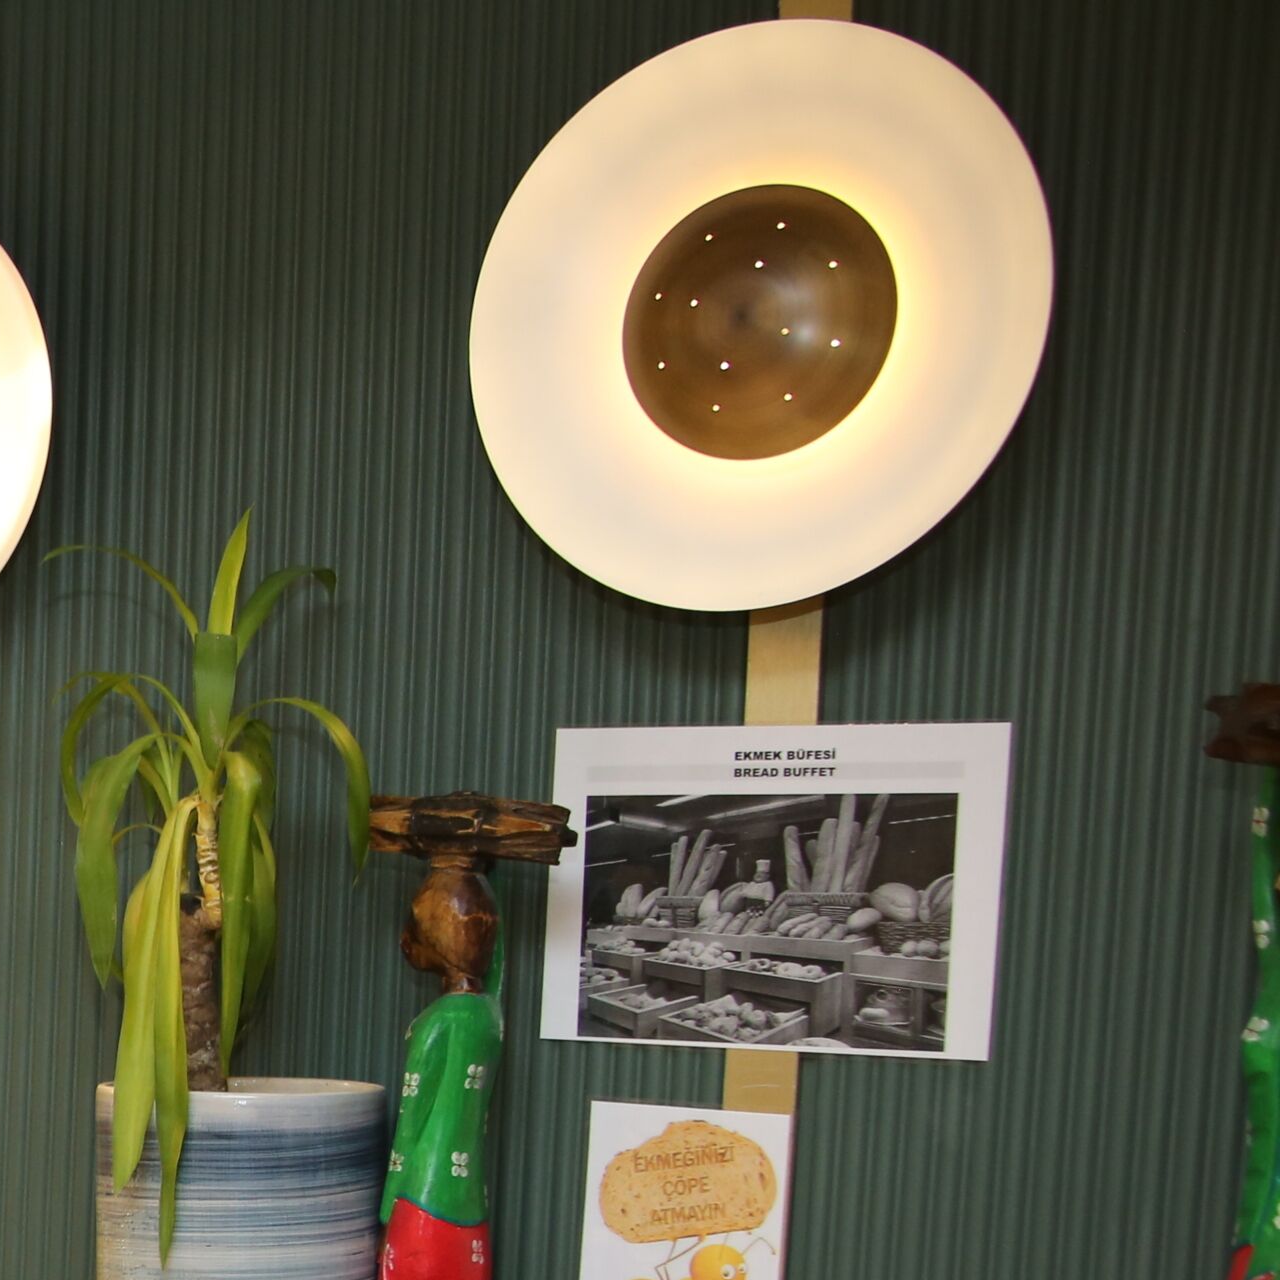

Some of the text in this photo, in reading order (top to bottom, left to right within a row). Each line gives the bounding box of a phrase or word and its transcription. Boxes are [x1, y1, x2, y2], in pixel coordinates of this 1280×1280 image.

[734, 747, 836, 761] EKMEK BÜFESİ
[733, 767, 837, 778] BREAD BUFFET
[662, 1175, 712, 1201] ÇÖPE
[649, 1202, 727, 1225] ATMAYIN
